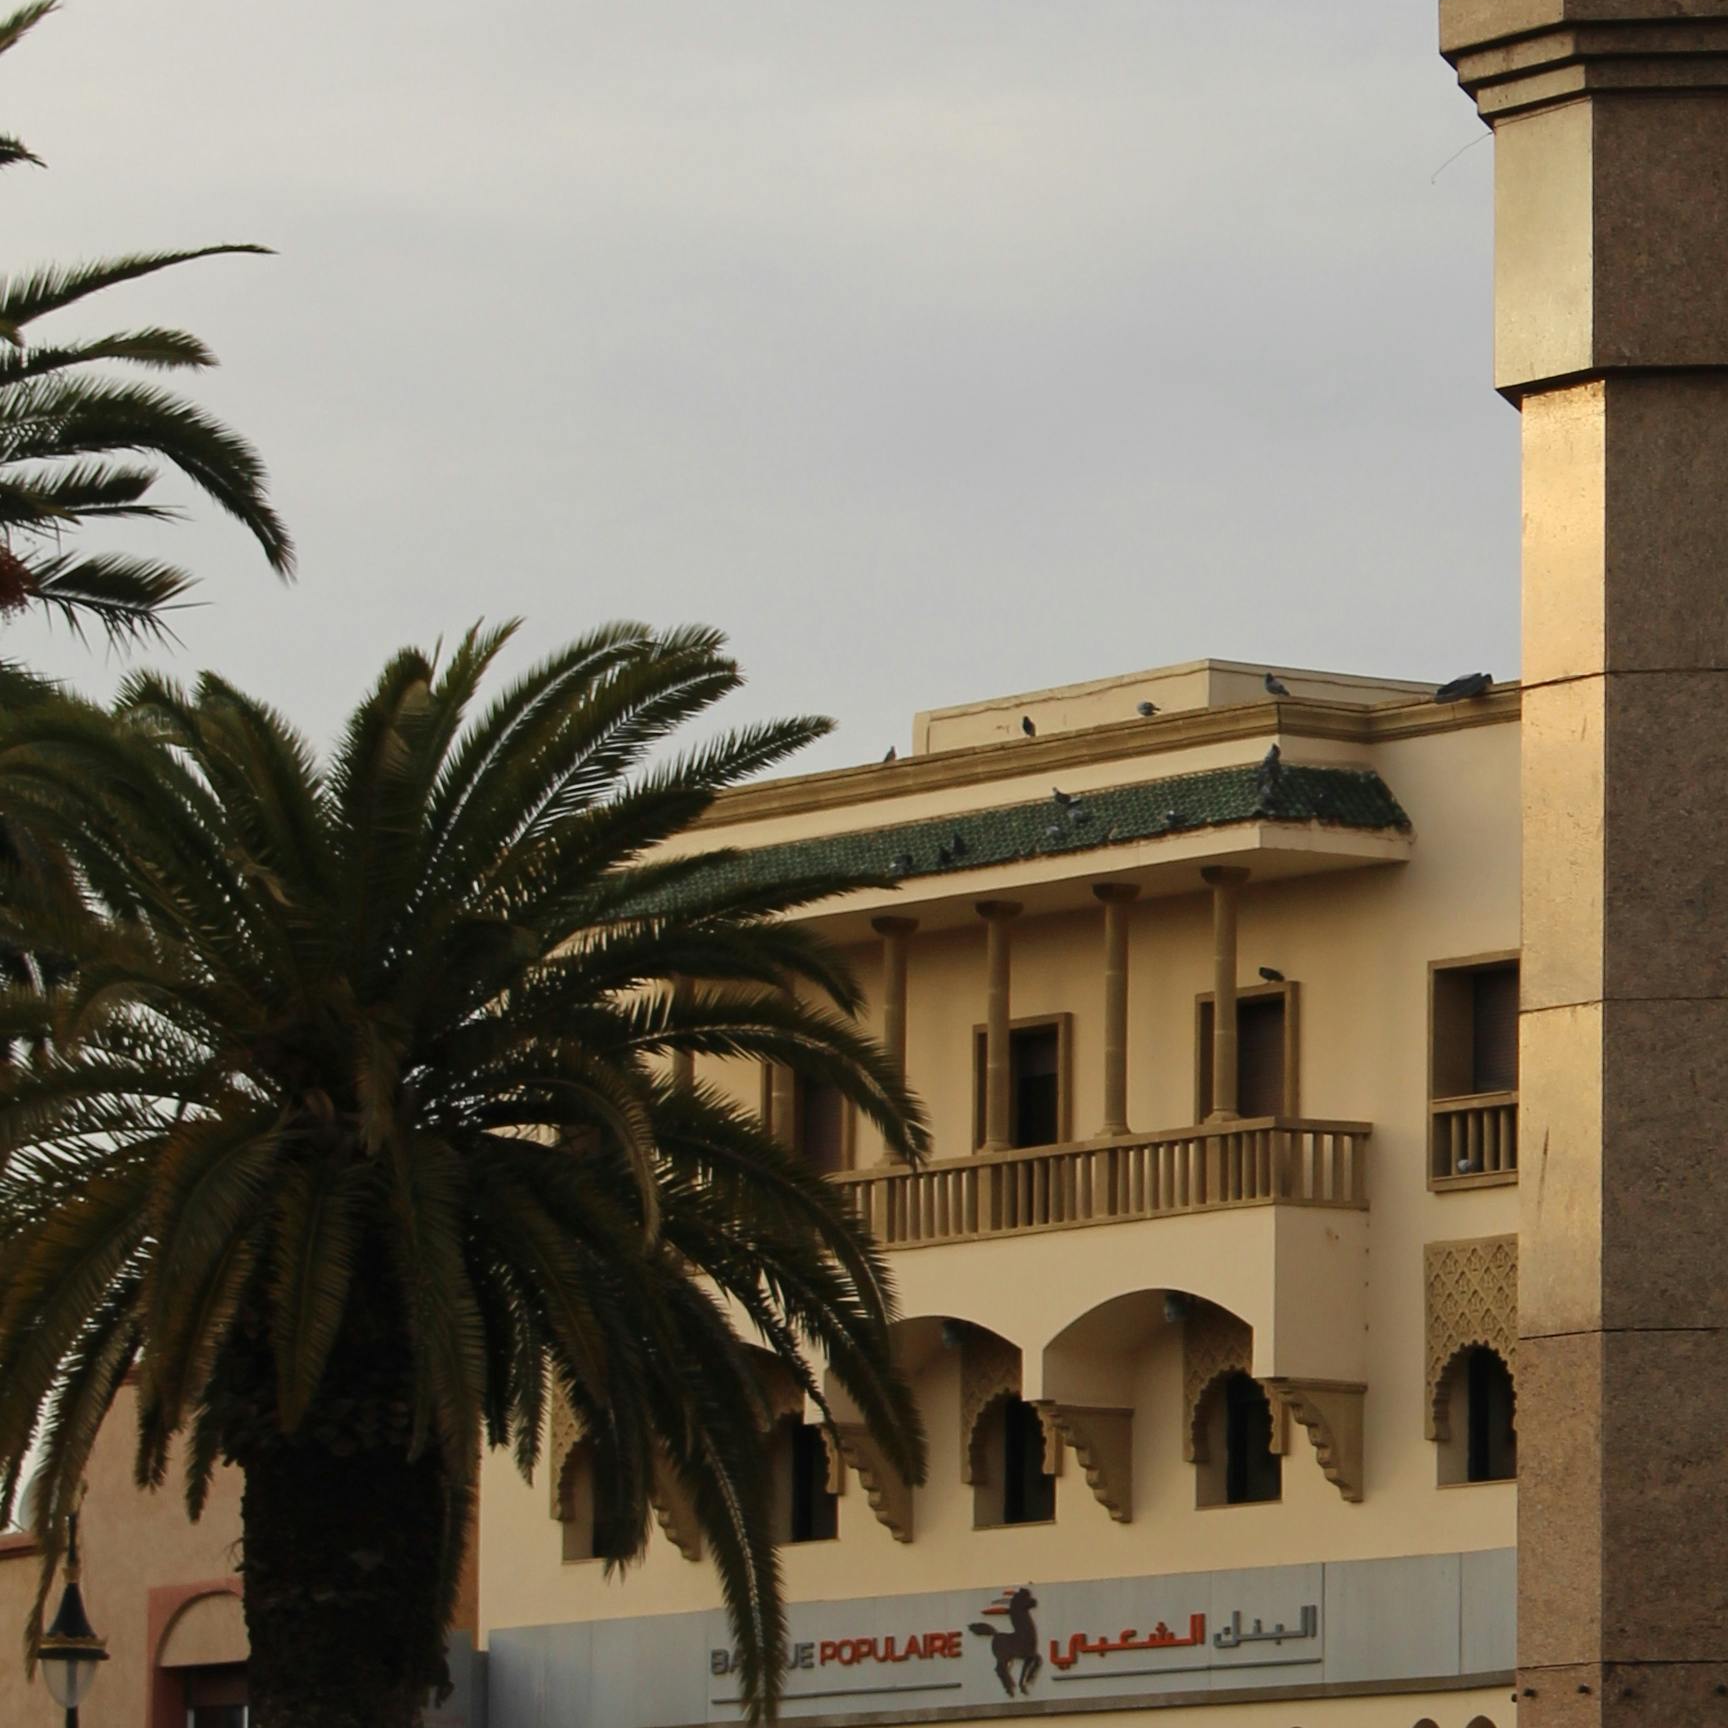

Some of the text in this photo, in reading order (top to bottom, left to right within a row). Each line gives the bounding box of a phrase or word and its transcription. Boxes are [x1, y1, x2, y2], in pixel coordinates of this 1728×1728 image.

[820, 1632, 963, 1666] POPULAIRE
[1050, 1604, 1318, 1671] البنك الشعبي
